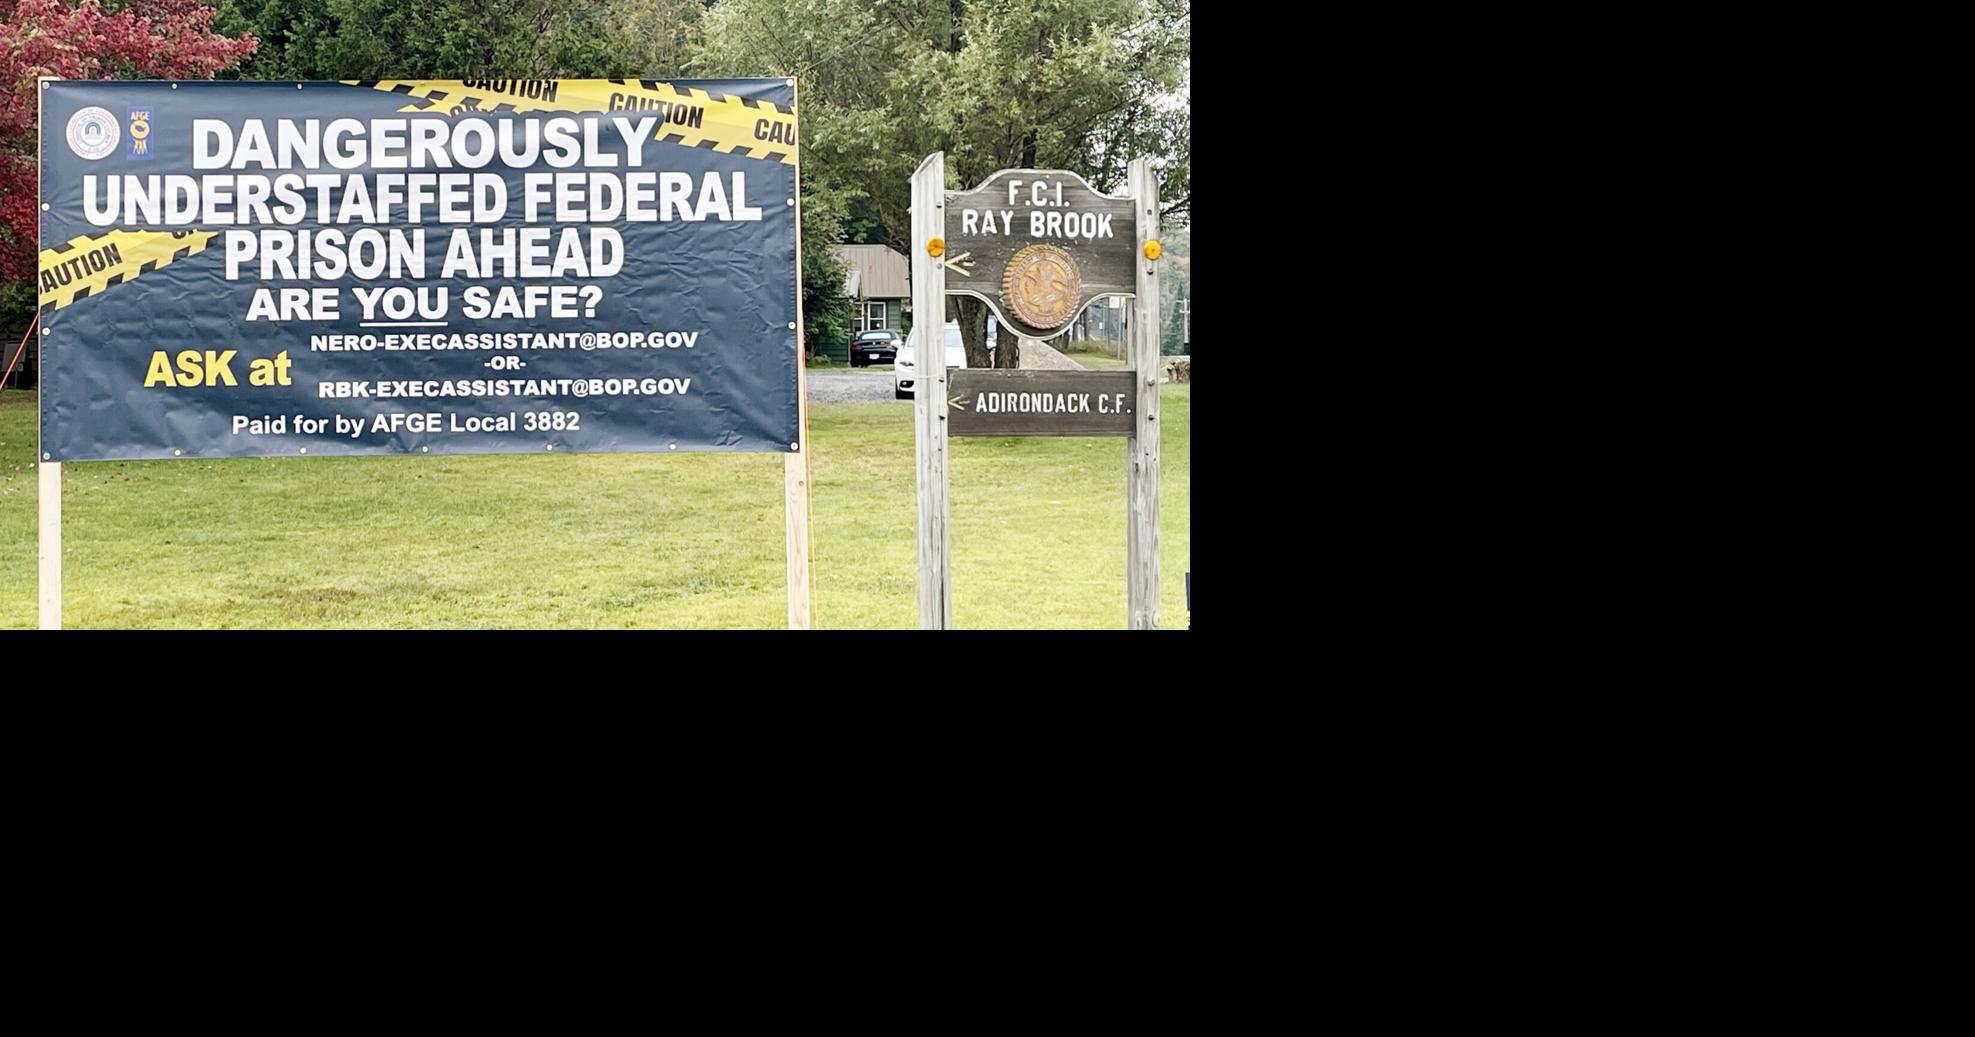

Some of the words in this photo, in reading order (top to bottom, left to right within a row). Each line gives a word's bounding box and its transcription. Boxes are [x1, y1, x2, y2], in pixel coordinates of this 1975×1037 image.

[130, 111, 150, 121] AFGE
[192, 116, 658, 170] DANGEROUSLY
[83, 173, 508, 226] UNDERSTAFFED
[524, 171, 763, 222] FEDERAL
[1008, 180, 1070, 207] F.C.I.
[962, 209, 1013, 236] RAY
[1030, 211, 1113, 239] BROOK
[225, 228, 425, 280] PRISON
[440, 227, 625, 278] AHEAD
[39, 242, 123, 295] AUTION
[245, 288, 340, 321] ARE
[351, 287, 449, 320] YOU
[462, 285, 603, 319] SAFE?
[310, 331, 699, 352] NERO-EXECASSISTANT@BOP.GOV
[143, 350, 238, 388] ASK
[249, 350, 292, 386] at
[484, 355, 527, 370] -OR-
[318, 378, 691, 398] RBK-EXECASSISTANT@BOP.GOV
[975, 392, 1091, 414] ADIRONDACK
[1098, 393, 1132, 414] C.F.
[232, 415, 287, 435] Paid
[293, 414, 329, 434] for
[335, 414, 366, 438] by
[370, 413, 442, 433] AFGE
[450, 412, 516, 432] Local
[523, 411, 580, 431] 3882
